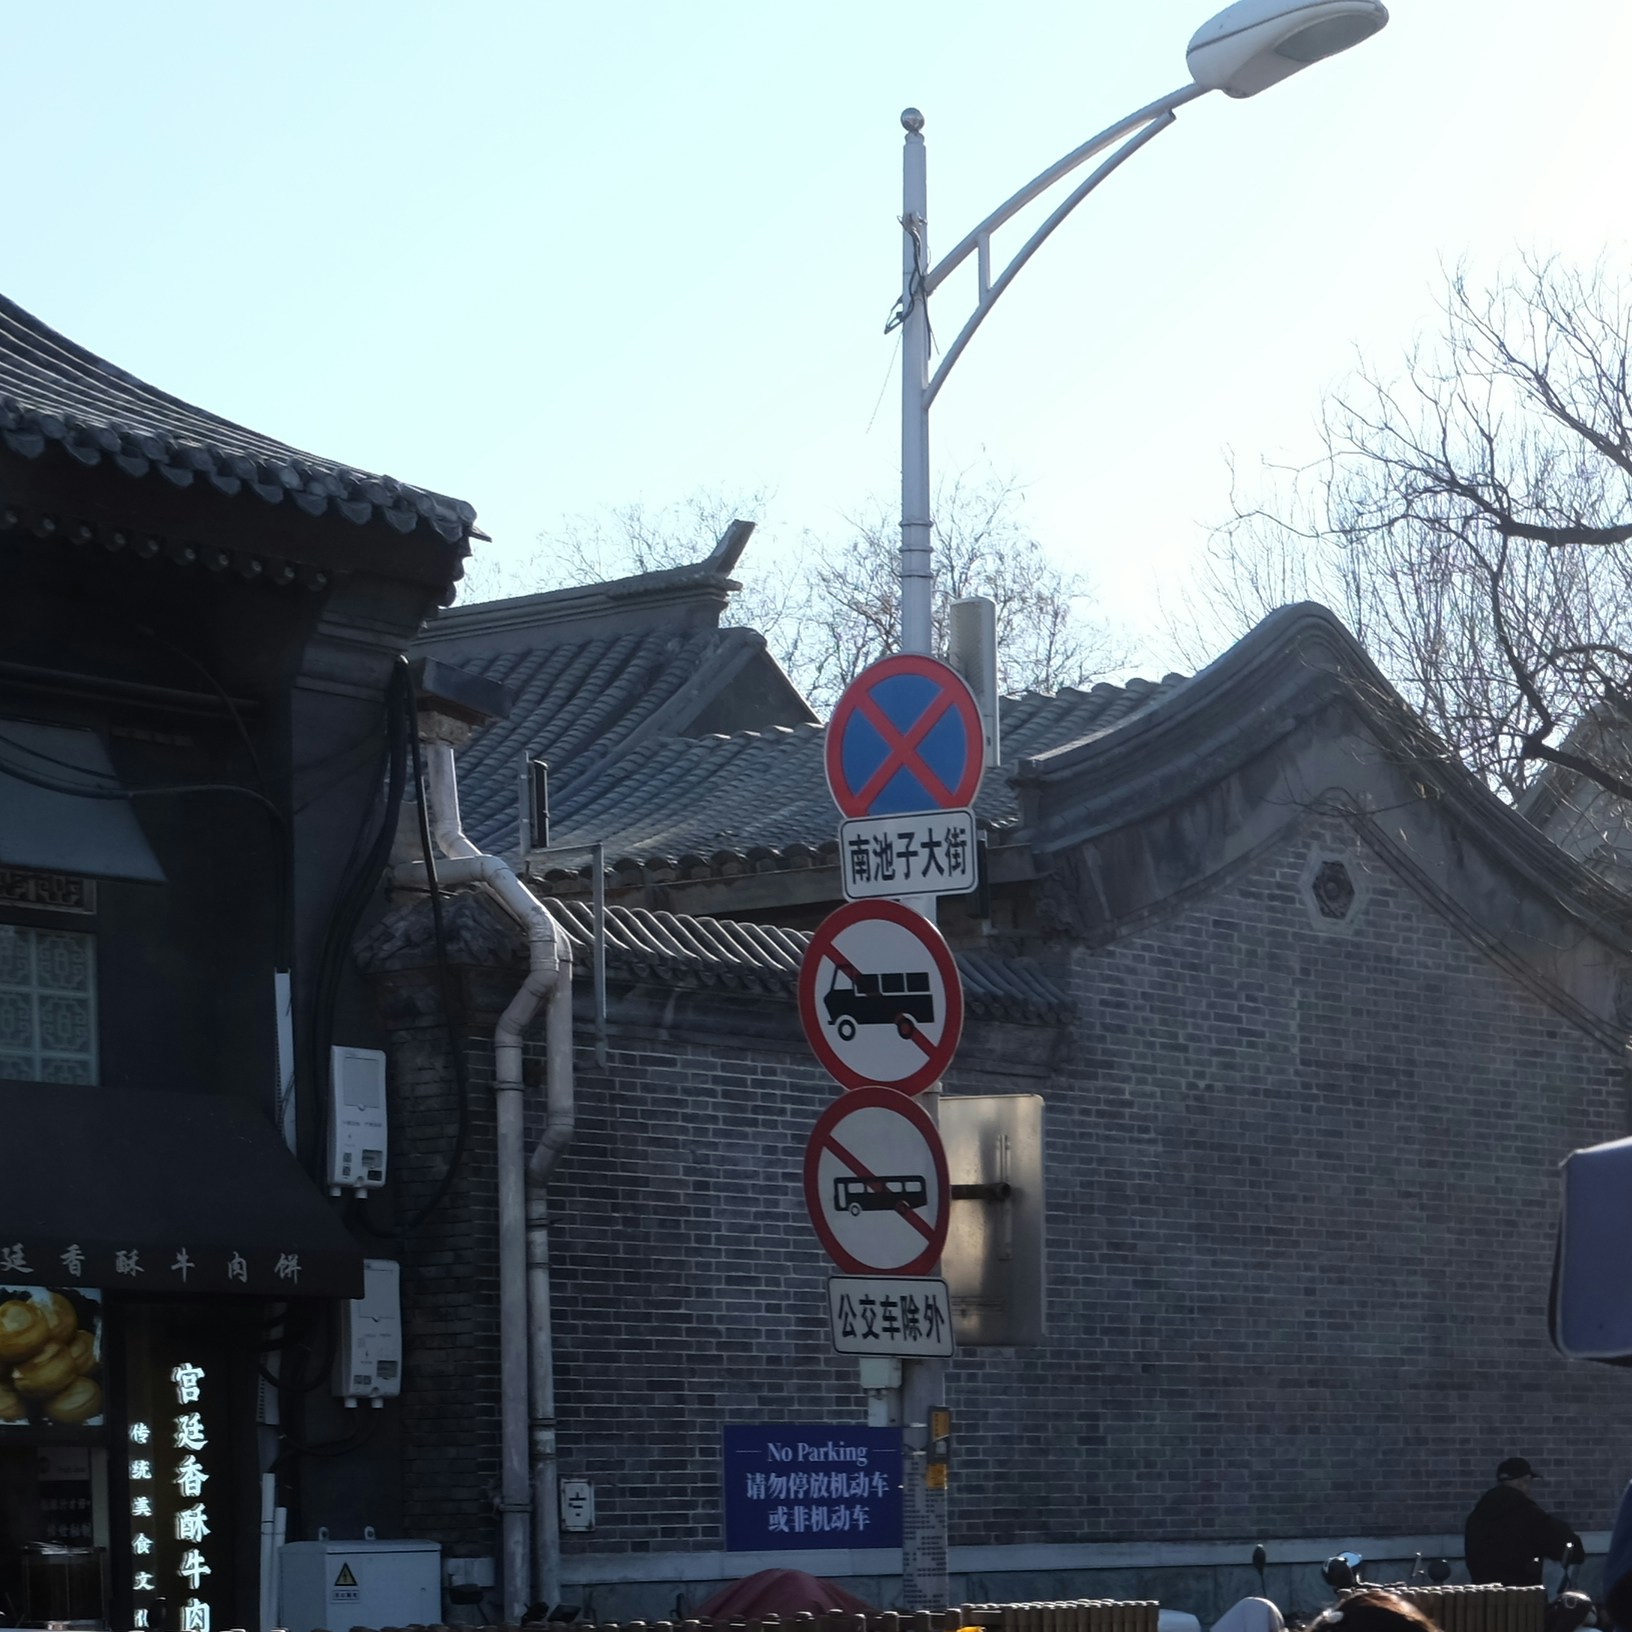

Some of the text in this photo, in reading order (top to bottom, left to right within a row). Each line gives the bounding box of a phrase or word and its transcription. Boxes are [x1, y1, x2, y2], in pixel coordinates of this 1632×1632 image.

[848, 826, 968, 885] 南池子大街
[838, 1293, 945, 1343] 公交车除外
[767, 1441, 868, 1467] No Parking
[746, 1471, 890, 1500] 请勿停放机动车
[767, 1504, 871, 1532] 或非机动车
